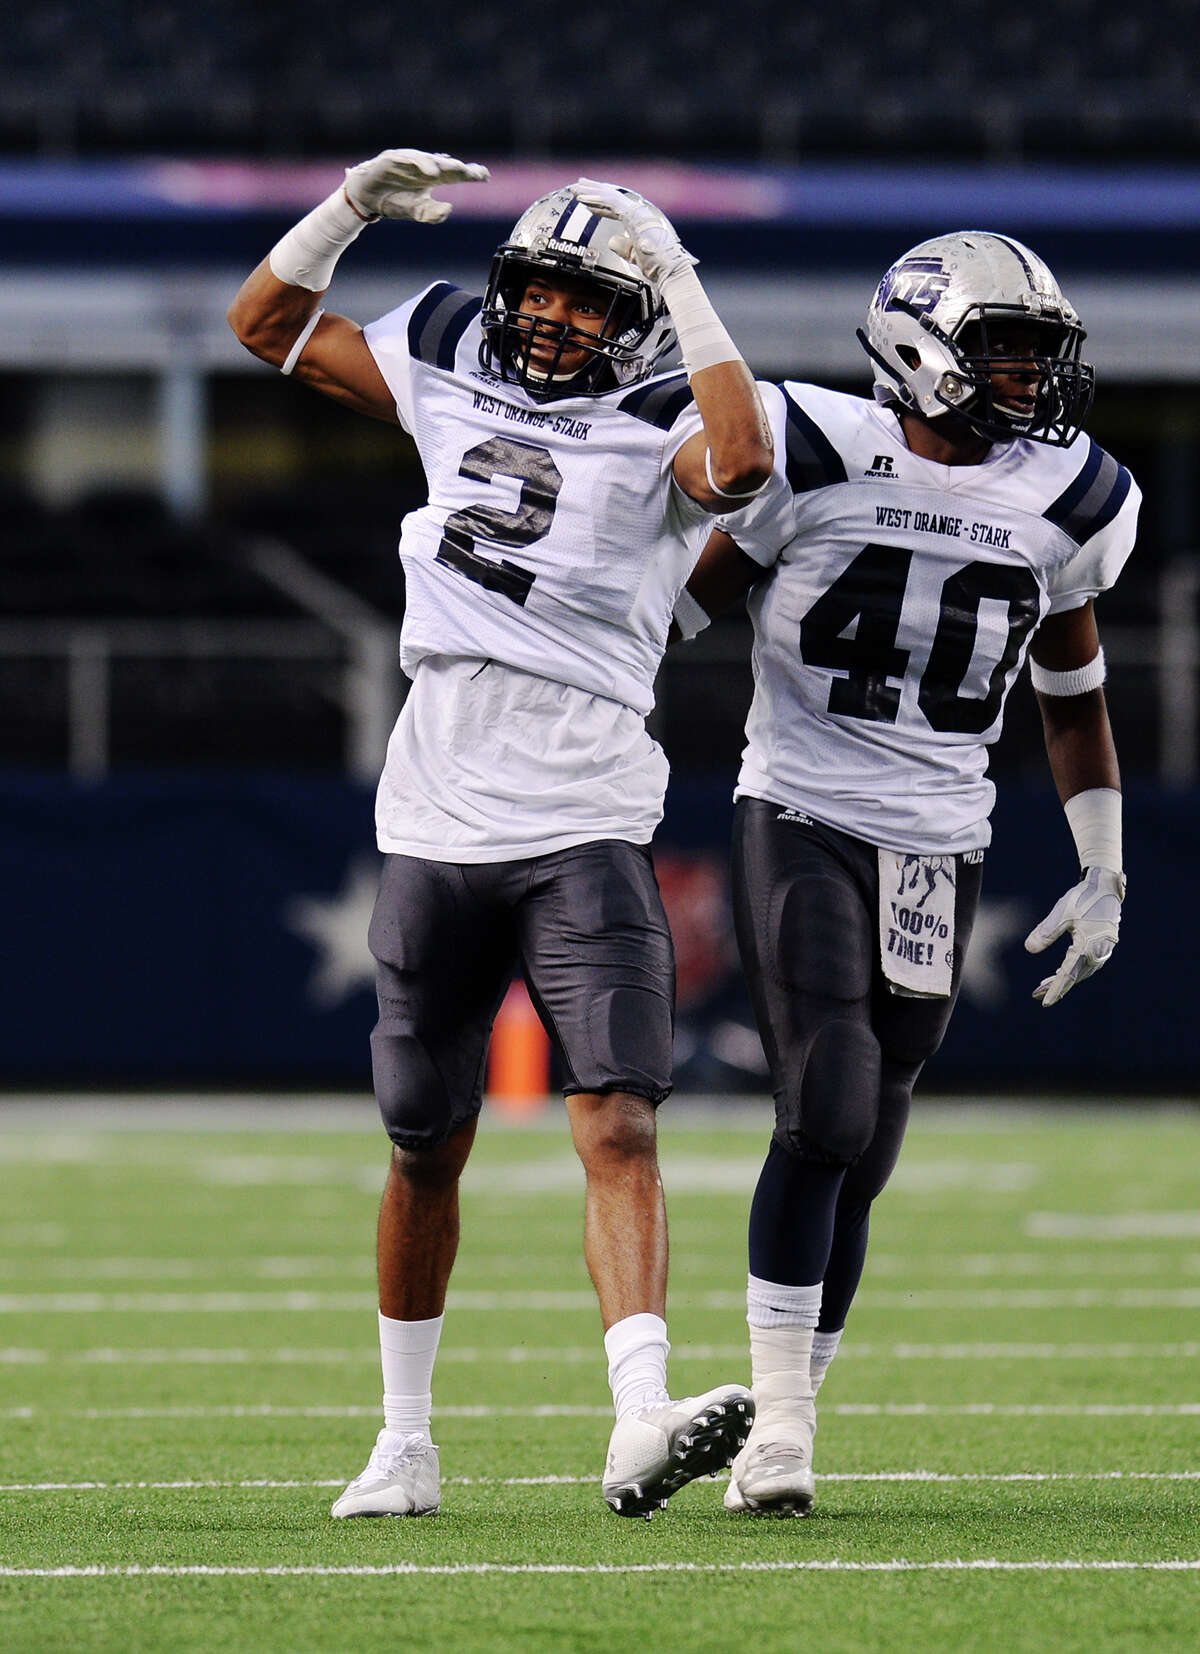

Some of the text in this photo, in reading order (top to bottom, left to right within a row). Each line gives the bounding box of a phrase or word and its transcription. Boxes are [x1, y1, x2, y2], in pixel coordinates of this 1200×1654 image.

[548, 238, 586, 257] Riddell
[473, 390, 505, 416] WEST
[552, 415, 593, 441] STARK
[864, 469, 900, 479] RUSSELL
[433, 435, 564, 608] 2
[876, 506, 912, 528] WEST
[914, 511, 963, 537] ORANGE
[970, 522, 1012, 549] STARK
[799, 543, 1041, 735] 40
[777, 812, 815, 828] RUSSELL
